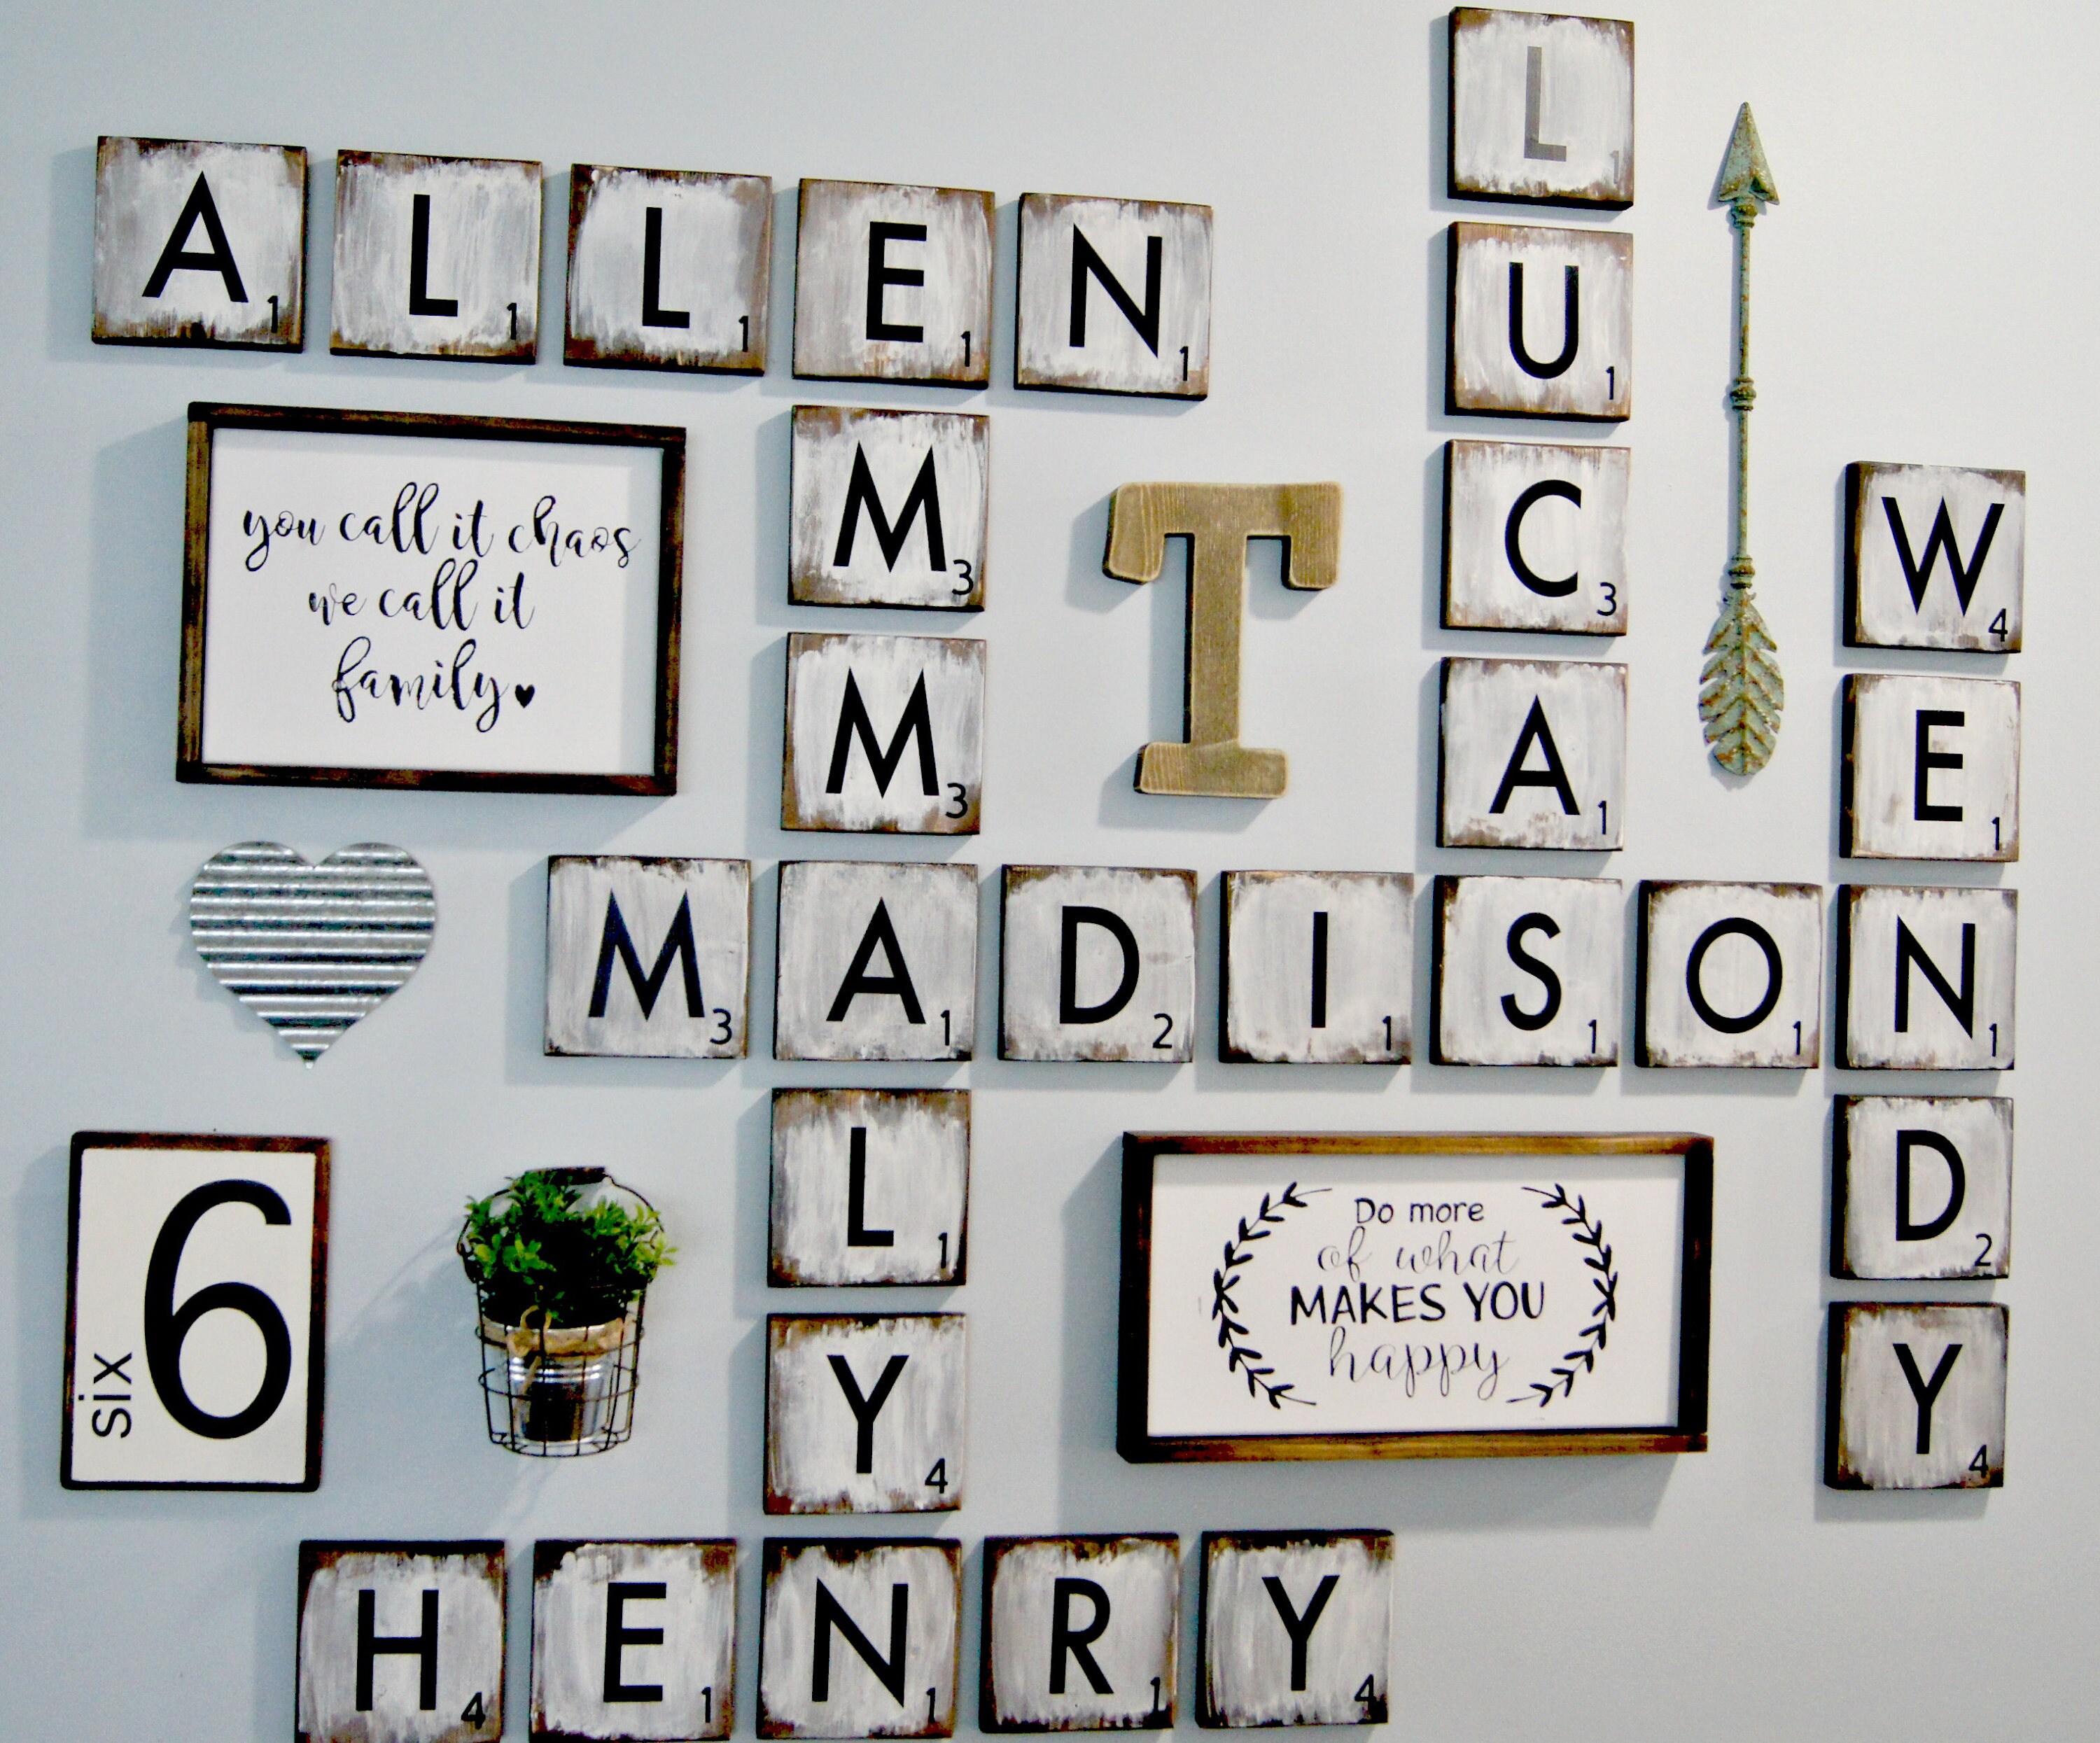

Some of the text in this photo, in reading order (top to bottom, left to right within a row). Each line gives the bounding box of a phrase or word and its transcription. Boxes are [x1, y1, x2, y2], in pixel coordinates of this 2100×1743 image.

[1610, 150, 1619, 184] 1
[142, 172, 1162, 357] ALLEN
[269, 296, 278, 332] 1
[509, 303, 518, 340] 1
[739, 316, 748, 352] 1
[961, 331, 970, 367] 1
[1180, 346, 1188, 381] 1
[1607, 367, 1614, 400] 1
[244, 482, 640, 571] you call it chaos
[309, 558, 535, 630] we call it
[952, 559, 974, 596] 3
[1598, 582, 1616, 616] 3
[1102, 482, 1344, 799] T
[1989, 609, 2008, 642] 4
[332, 636, 510, 732] family
[946, 783, 968, 819] 3
[1599, 801, 1606, 834] 1
[1992, 818, 1999, 850] 1
[589, 892, 1976, 1039] MADISON
[710, 1009, 732, 1044] 3
[941, 1011, 950, 1046] 1
[1153, 1014, 1172, 1049] 2
[1383, 1016, 1392, 1051] 1
[1590, 1020, 1596, 1054] 1
[1794, 1021, 1800, 1055] 1
[1990, 1024, 1996, 1057] 1
[1355, 1198, 1485, 1224] Do more
[939, 1233, 948, 1269] 1
[1318, 1226, 1519, 1281] of what
[1975, 1234, 1991, 1266] 2
[145, 1180, 291, 1439] 6
[1291, 1280, 1546, 1325] MAKES YOU
[1330, 1326, 1510, 1400] happy
[78, 1352, 132, 1438] six
[925, 1460, 948, 1494] 4
[1969, 1446, 1989, 1479] 4
[356, 1576, 1339, 1712] HENRY
[462, 1693, 486, 1728] 4
[701, 1687, 710, 1723] 1
[927, 1688, 937, 1725] 1
[1150, 1678, 1161, 1715] 1
[1355, 1674, 1375, 1712] 4
